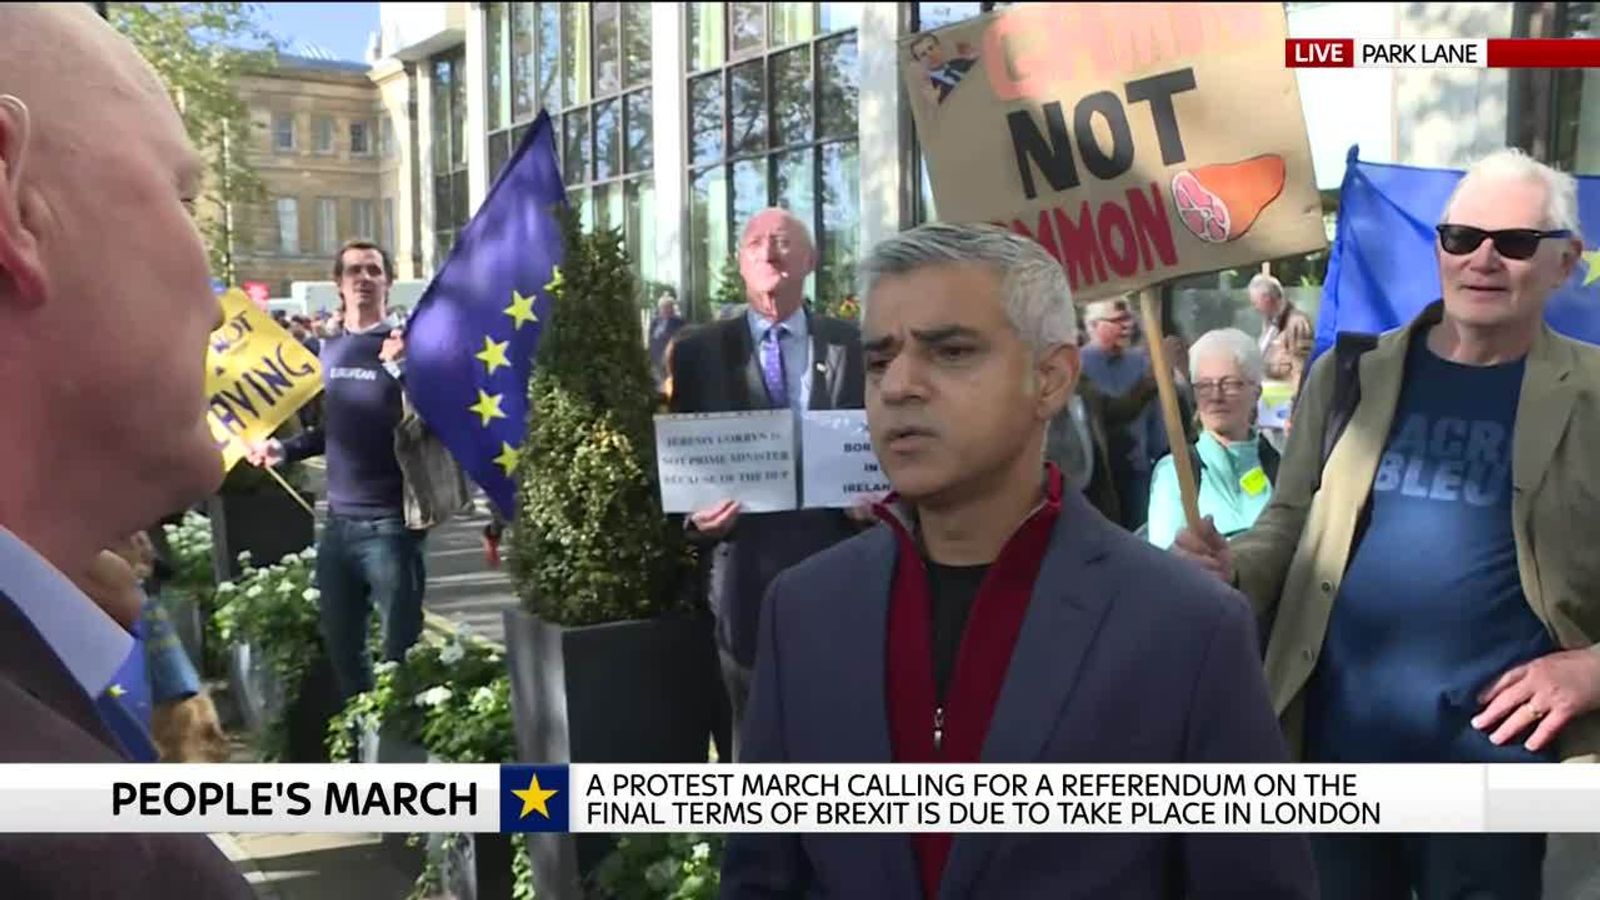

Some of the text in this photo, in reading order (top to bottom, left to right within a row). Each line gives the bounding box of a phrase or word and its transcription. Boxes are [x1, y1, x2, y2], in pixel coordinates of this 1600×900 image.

[1007, 67, 1197, 200] NOT
[992, 181, 1179, 292] MMON
[207, 343, 315, 438] AVING
[717, 431, 768, 444] CORBYN
[843, 443, 871, 453] BOR
[688, 453, 726, 466] PRIME
[729, 450, 789, 463] MINISTER
[864, 463, 878, 472] IN
[739, 471, 762, 482] THE
[1374, 452, 1510, 507] BLEU
[843, 483, 891, 494] IRELAN
